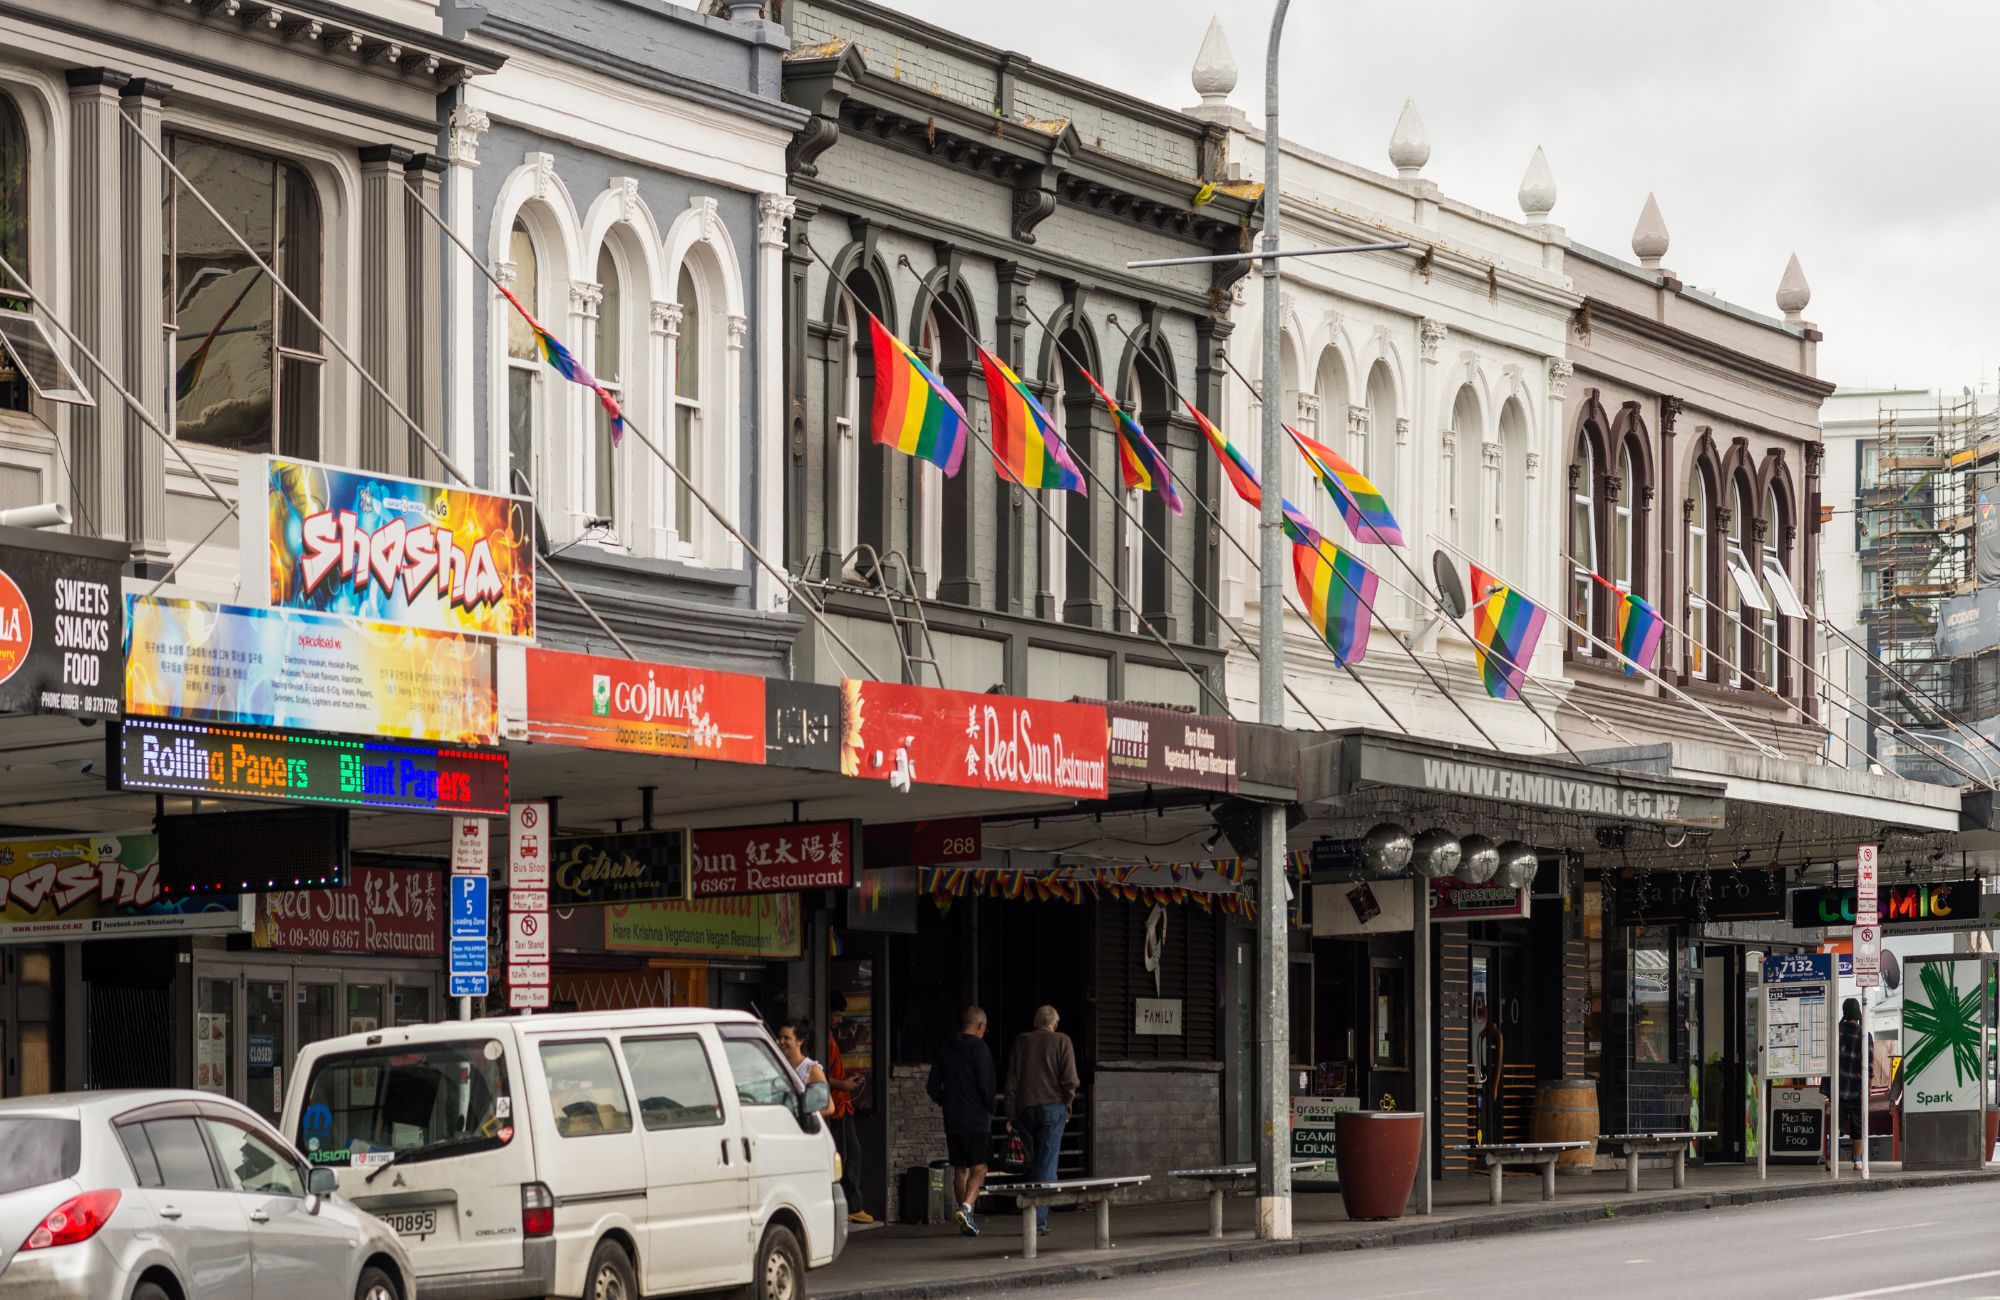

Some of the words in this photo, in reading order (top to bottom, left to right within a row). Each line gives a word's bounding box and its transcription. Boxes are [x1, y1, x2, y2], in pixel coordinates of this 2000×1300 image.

[55, 577, 109, 616] SWEETS
[55, 614, 109, 652] SNACKS
[63, 652, 100, 687] FOOD
[41, 691, 61, 709] PHONE
[61, 694, 80, 710] ORDER
[84, 696, 92, 712] 09
[93, 697, 103, 713] 379
[104, 698, 118, 714] 7722
[616, 726, 653, 746] Japanese
[983, 703, 1018, 782] Red
[1018, 708, 1052, 785] Sun
[1053, 732, 1105, 790] Restaurant
[143, 734, 224, 786] Rolling
[231, 743, 309, 789] Papers
[340, 754, 396, 794] Blunt
[400, 758, 472, 802] Papers
[943, 836, 976, 856] 268
[457, 856, 468, 864] Mon
[473, 856, 484, 864] Sun
[513, 862, 527, 873] Bus
[528, 862, 546, 873] Stop
[701, 878, 737, 893] 6367
[746, 869, 844, 890] Restaurant
[463, 878, 475, 898] P
[466, 900, 473, 915] 5
[514, 901, 527, 909] Mon
[532, 901, 544, 909] Sun
[1818, 886, 1953, 923] COMIC
[12, 923, 84, 933] WWW.SHOSHA.CO.NZ
[267, 923, 286, 946] Ph:
[289, 928, 329, 948] 09-309
[332, 930, 360, 949] 6367
[365, 916, 436, 951] Restaurant
[613, 923, 631, 940] Hare
[633, 924, 664, 942] Krishna
[665, 925, 705, 947] Vegetarian
[707, 929, 730, 949] Vegan
[731, 930, 772, 949] Restaurant
[515, 940, 526, 949] Taxi
[527, 940, 545, 949] Stand
[1780, 960, 1813, 972] 7132
[511, 970, 527, 979] 12am
[474, 985, 482, 993] Fri
[514, 992, 527, 1001] Mon
[532, 992, 545, 1001] Sun
[1144, 1009, 1174, 1025] FAMILY
[249, 1047, 272, 1063] CLOSED
[1916, 1091, 1953, 1104] Spark
[1296, 1131, 1336, 1142] GAMI
[1295, 1144, 1336, 1154] LOUN
[475, 1227, 517, 1237] DELICA
